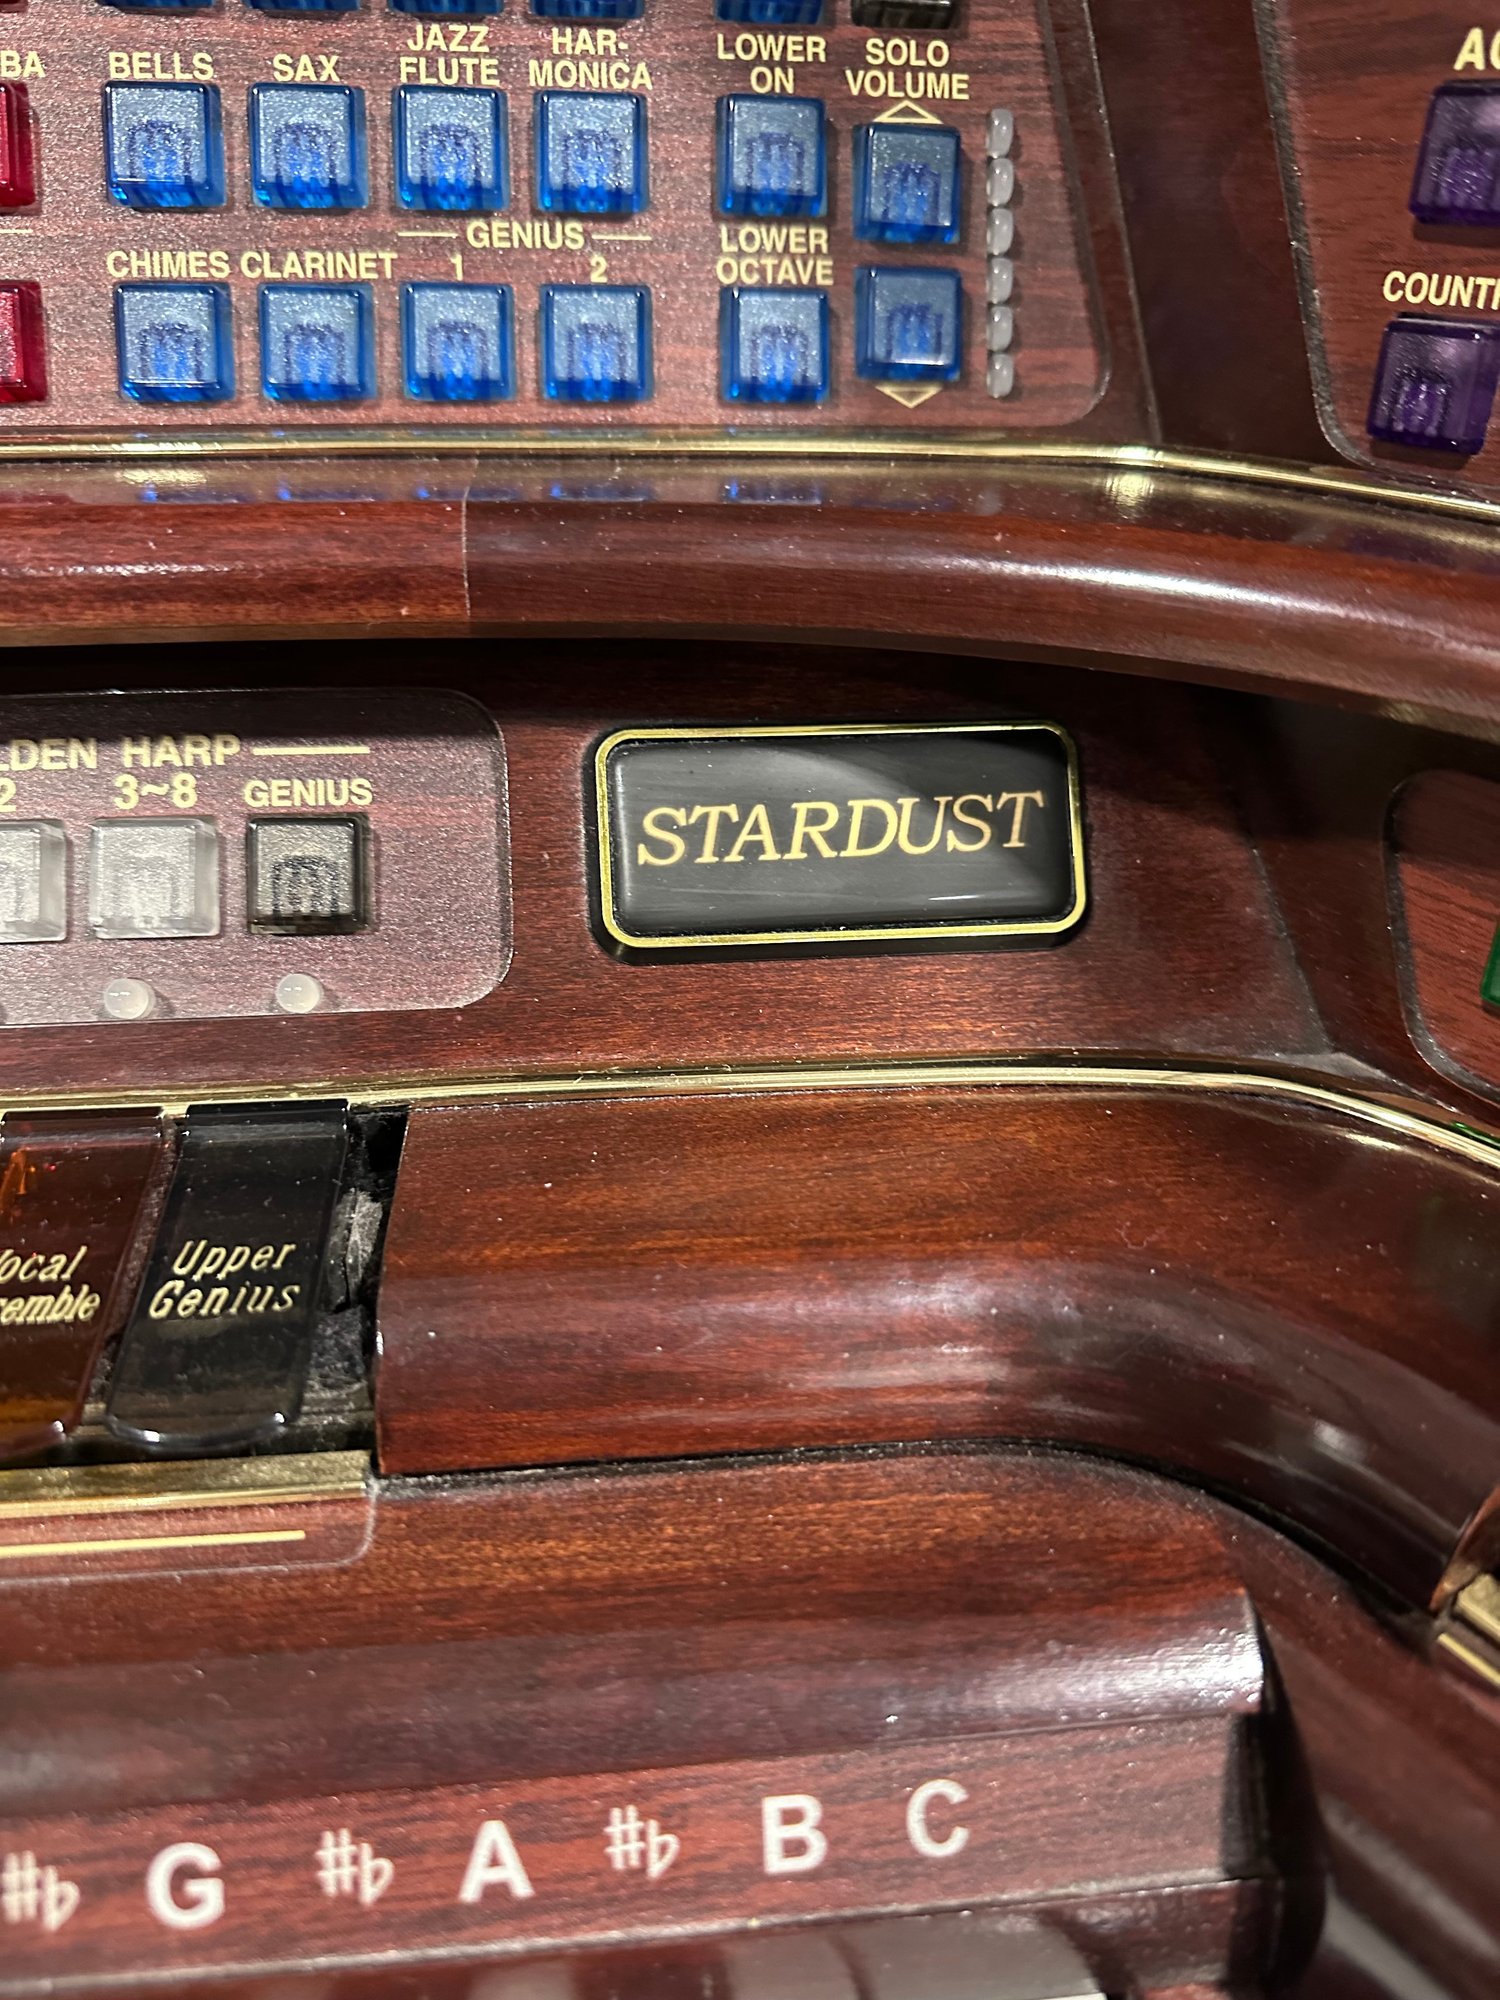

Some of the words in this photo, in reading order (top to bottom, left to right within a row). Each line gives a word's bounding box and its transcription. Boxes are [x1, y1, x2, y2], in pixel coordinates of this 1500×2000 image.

[406, 25, 490, 52] JAZZ
[551, 28, 629, 57] HAR-
[716, 33, 827, 62] LOWER
[865, 38, 950, 67] SOLO
[108, 51, 215, 80] BELLS
[272, 54, 341, 82] SAX
[400, 57, 501, 85] FLUTE
[528, 60, 653, 90] MONICA
[750, 66, 795, 94] ON
[845, 69, 970, 100] VOLUME
[466, 221, 585, 250] GENIUS
[720, 223, 829, 254] LOWER
[106, 250, 231, 279] CHIMES
[239, 251, 398, 280] CLARINET
[451, 254, 464, 281] 1
[589, 257, 608, 283] 2
[715, 256, 834, 286] OCTAVE
[122, 734, 242, 769] HARP
[113, 772, 199, 810] 3~8
[243, 777, 374, 808] GENIUS
[637, 790, 1046, 866] STARDUST
[172, 1239, 297, 1282] Upper
[149, 1279, 301, 1321] Genius
[146, 1842, 226, 1930] G
[457, 1819, 535, 1904] A
[760, 1794, 829, 1874] B
[905, 1778, 971, 1859] C
